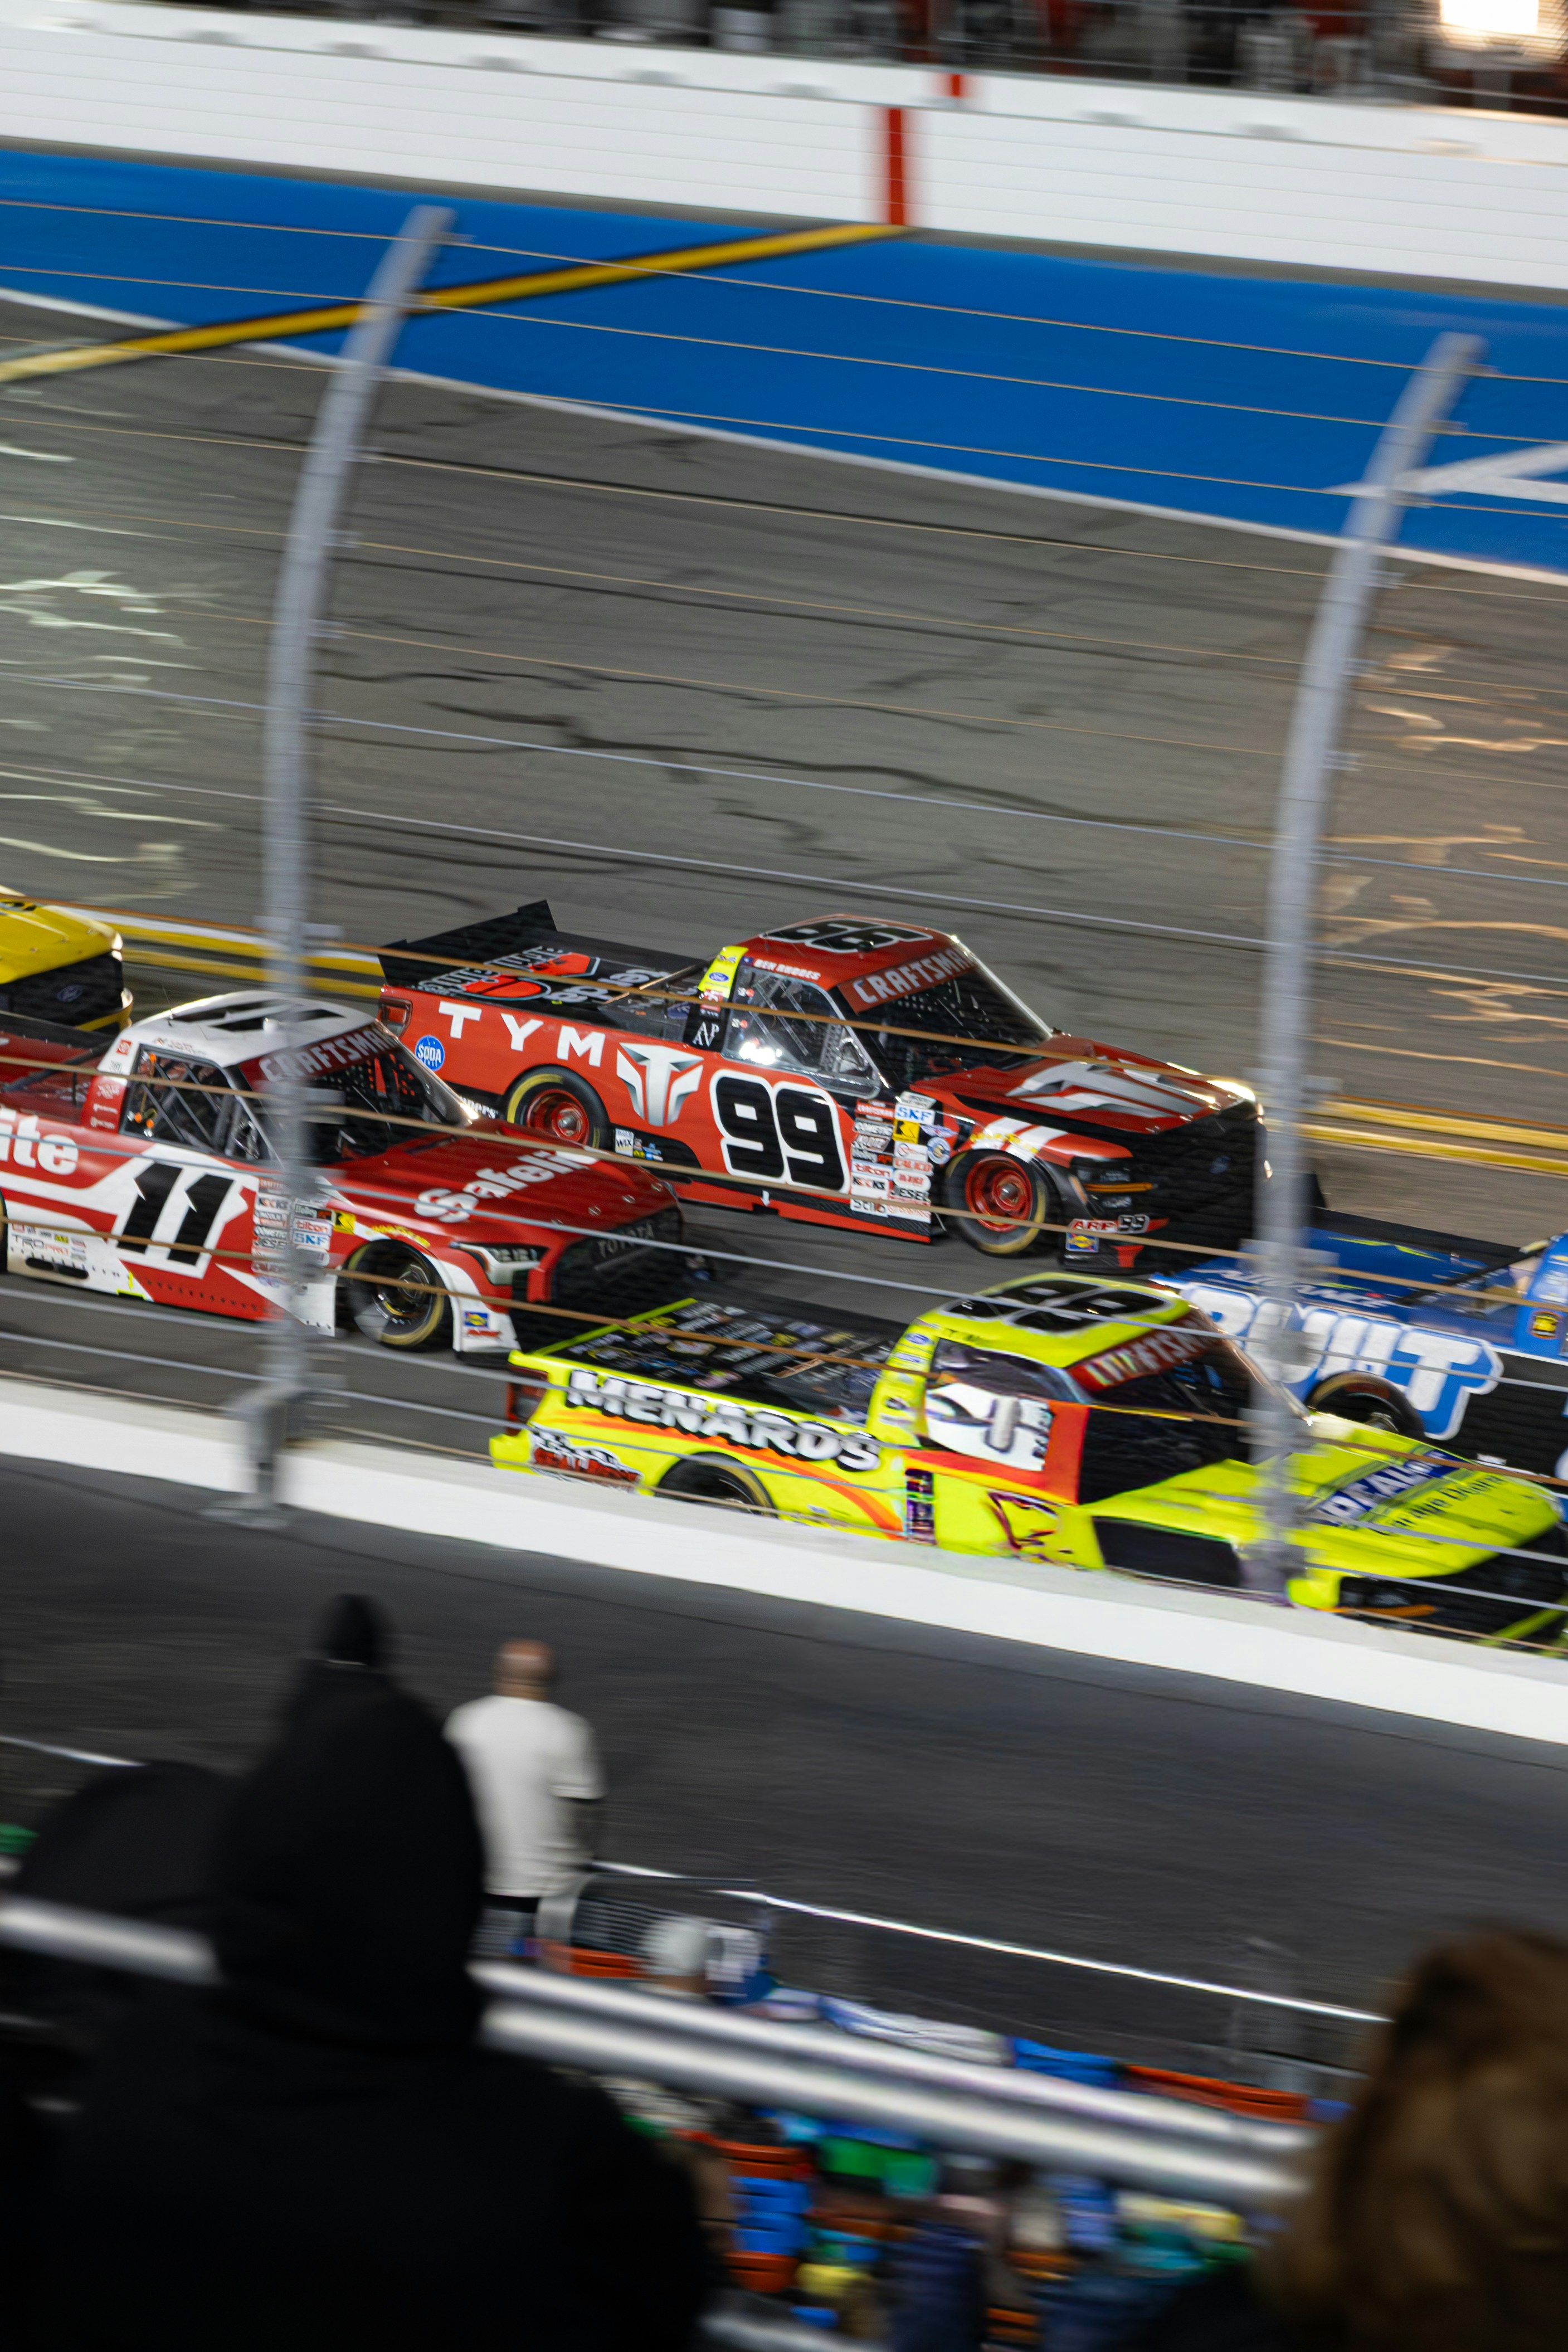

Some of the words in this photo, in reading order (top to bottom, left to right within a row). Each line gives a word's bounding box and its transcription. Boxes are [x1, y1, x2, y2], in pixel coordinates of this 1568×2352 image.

[417, 1044, 441, 1063] SODA
[712, 1073, 848, 1193] 99
[896, 1106, 933, 1121] SKF
[116, 1162, 235, 1266] 11
[294, 1232, 327, 1245] SKF
[567, 1369, 882, 1471] MENARDS
